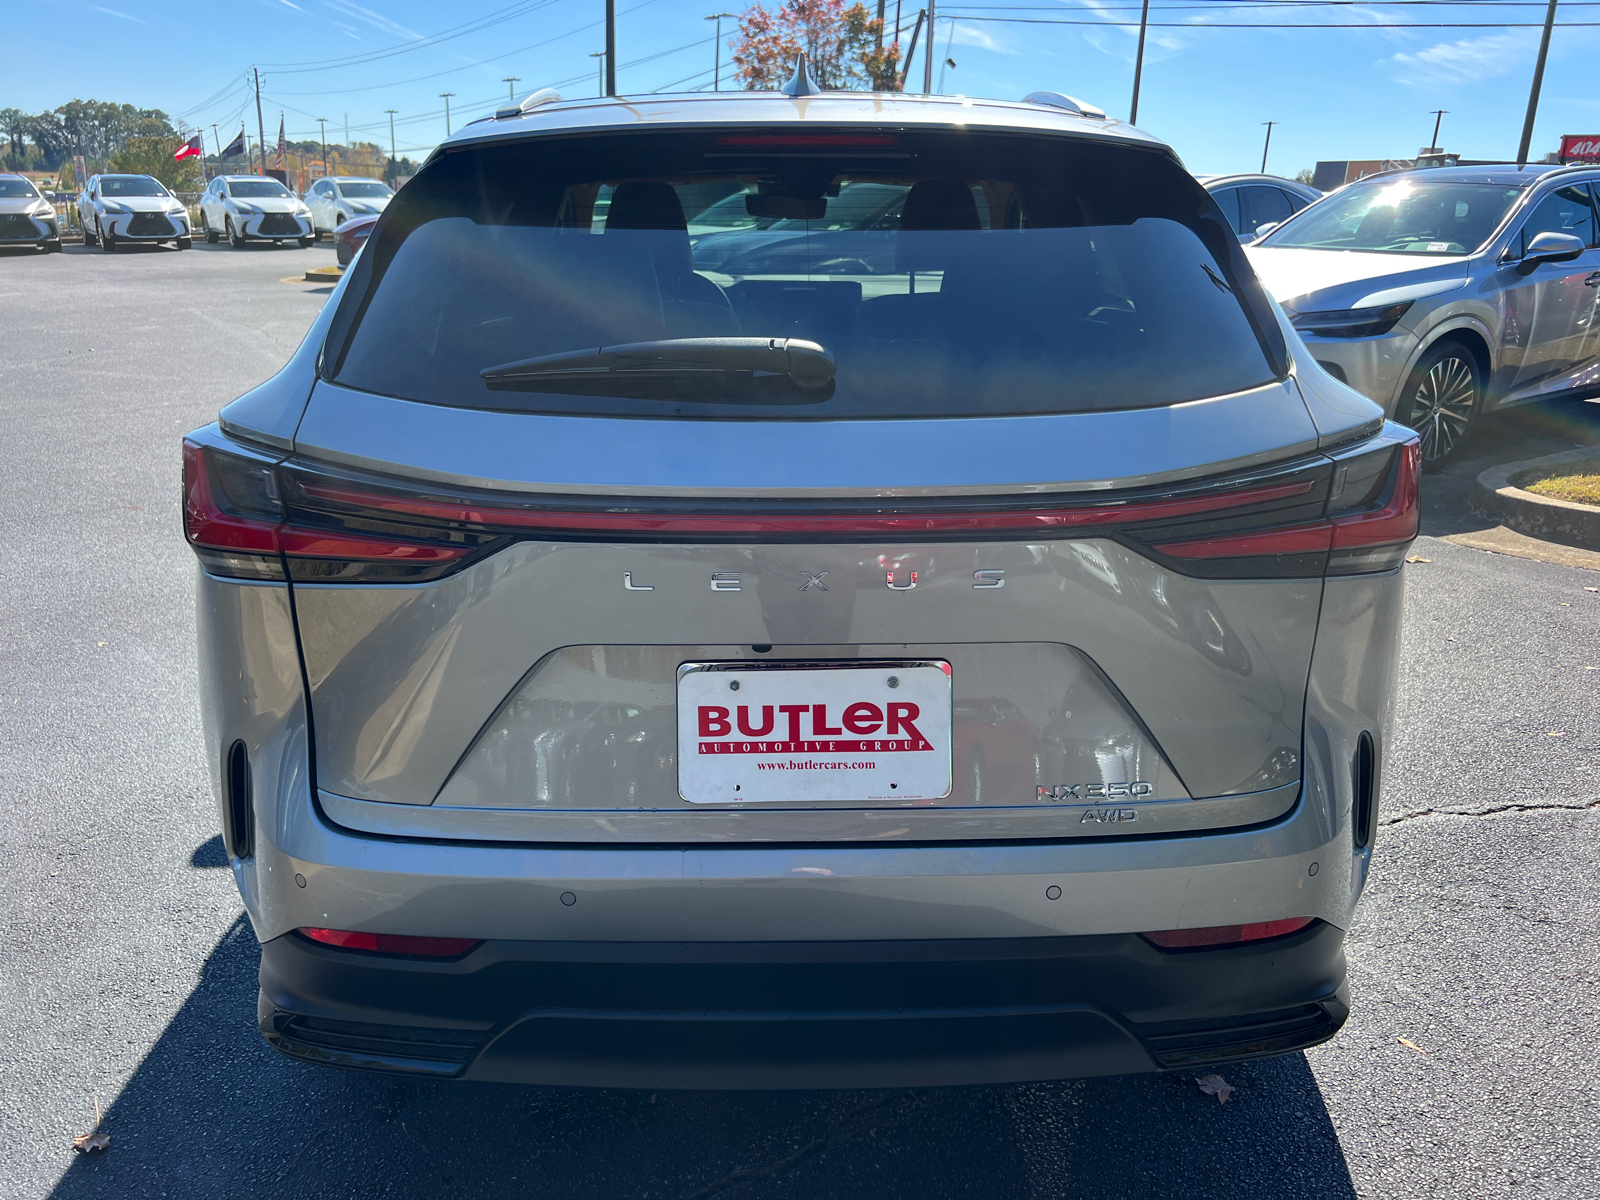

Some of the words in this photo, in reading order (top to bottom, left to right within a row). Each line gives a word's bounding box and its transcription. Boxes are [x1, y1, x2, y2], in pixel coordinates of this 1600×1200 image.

[623, 569, 1006, 592] LEXUS
[699, 742, 836, 753] AUTOMOTIVE
[859, 740, 926, 752] GROUP
[757, 760, 876, 771] www.butlercars.com
[1080, 809, 1139, 824] AWD
